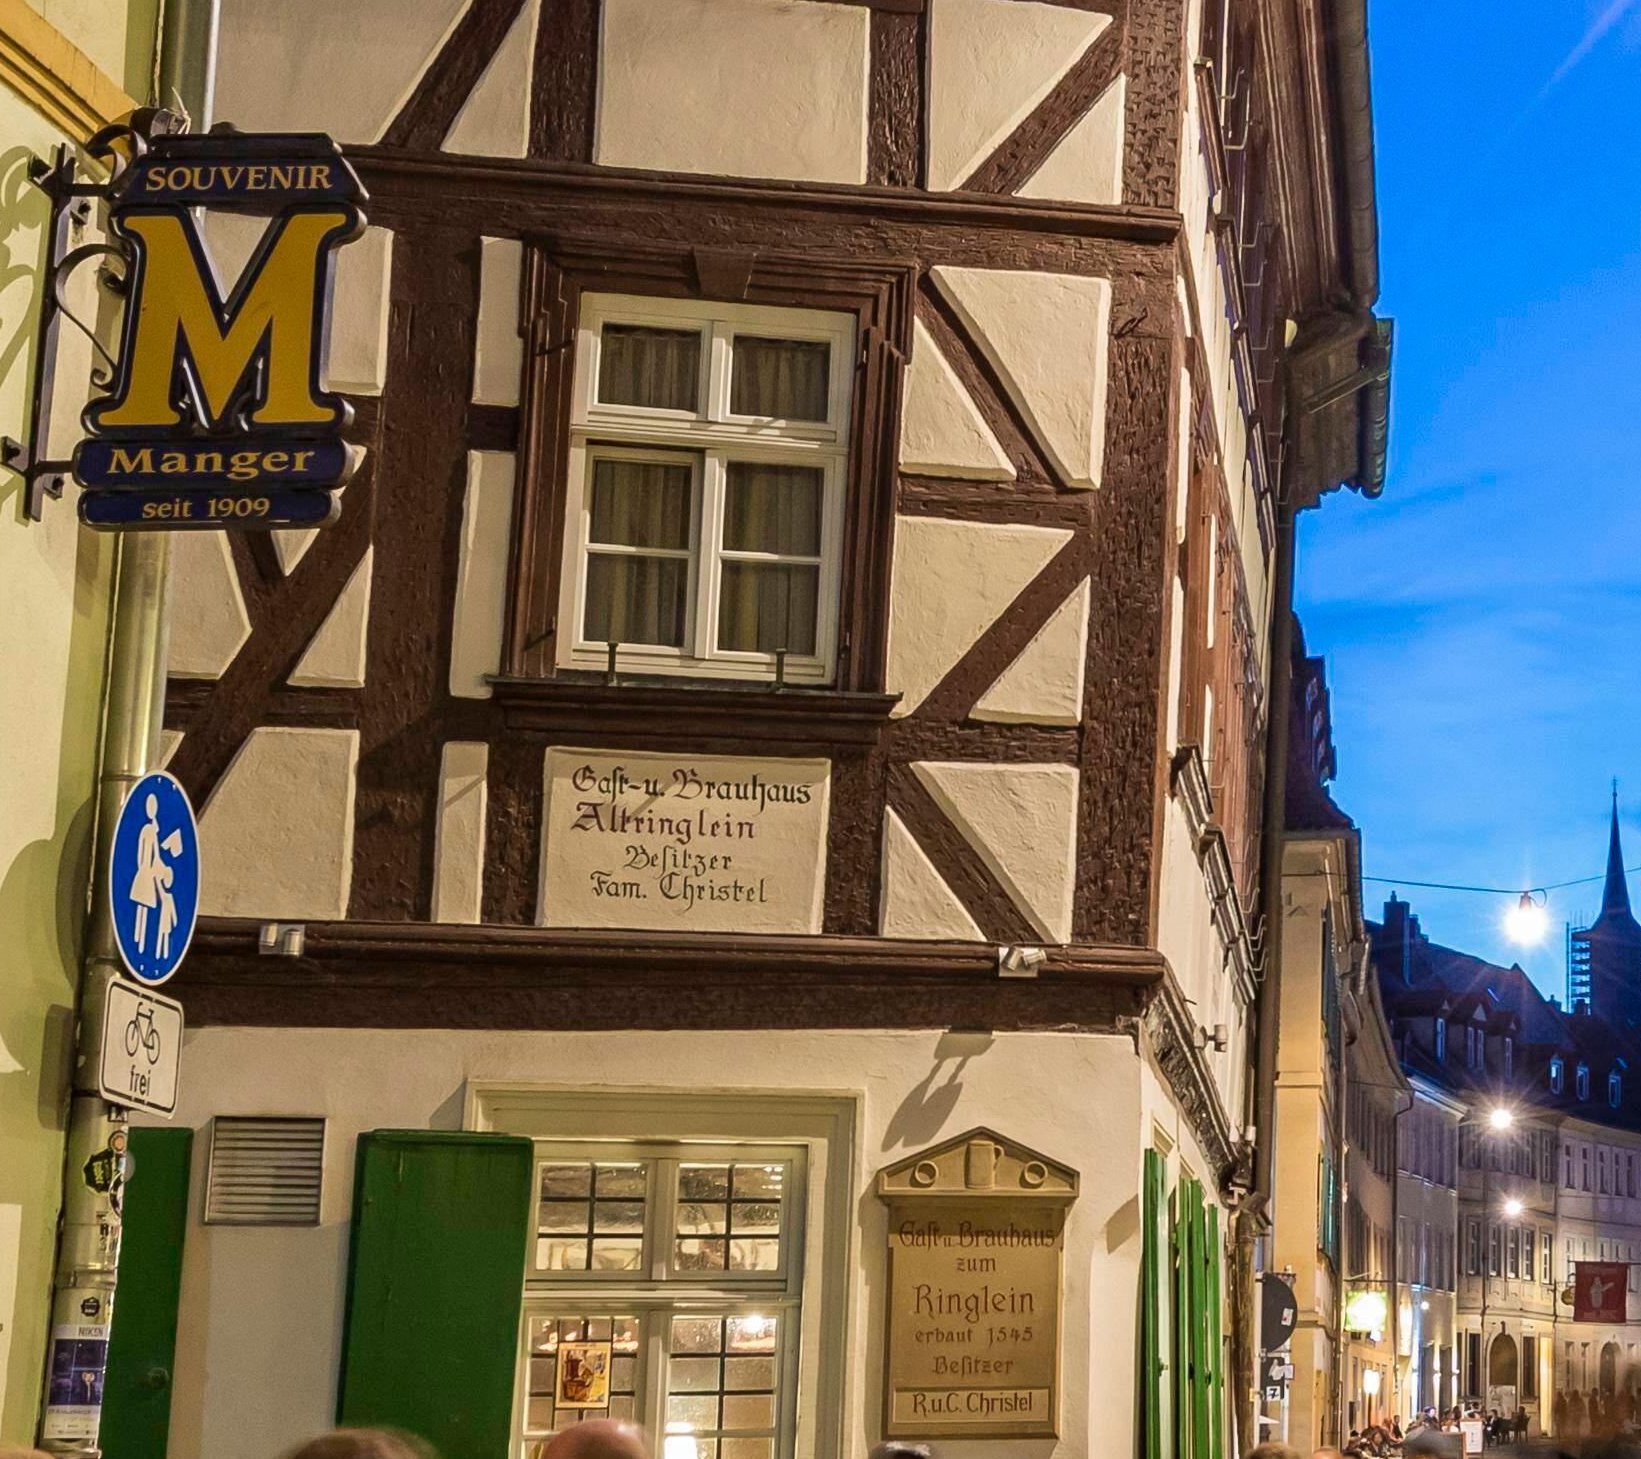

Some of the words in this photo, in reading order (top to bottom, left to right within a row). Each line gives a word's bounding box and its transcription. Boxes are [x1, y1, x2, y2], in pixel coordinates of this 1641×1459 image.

[145, 164, 334, 193] SOUVENIR
[98, 213, 349, 425] M
[106, 447, 317, 480] Manger
[142, 499, 192, 520] seit
[207, 496, 271, 519] 1909
[672, 767, 813, 814] Brauhaus
[589, 870, 647, 901] Fam.
[658, 871, 769, 914] Christel
[129, 1064, 151, 1097] frei
[957, 1219, 1056, 1249] Brauhaus
[955, 1256, 997, 1273] zum
[912, 1283, 1035, 1324] Ringlein
[914, 1326, 974, 1344] erbaut
[986, 1325, 1034, 1348] 1545
[966, 1390, 1034, 1417] Christel
